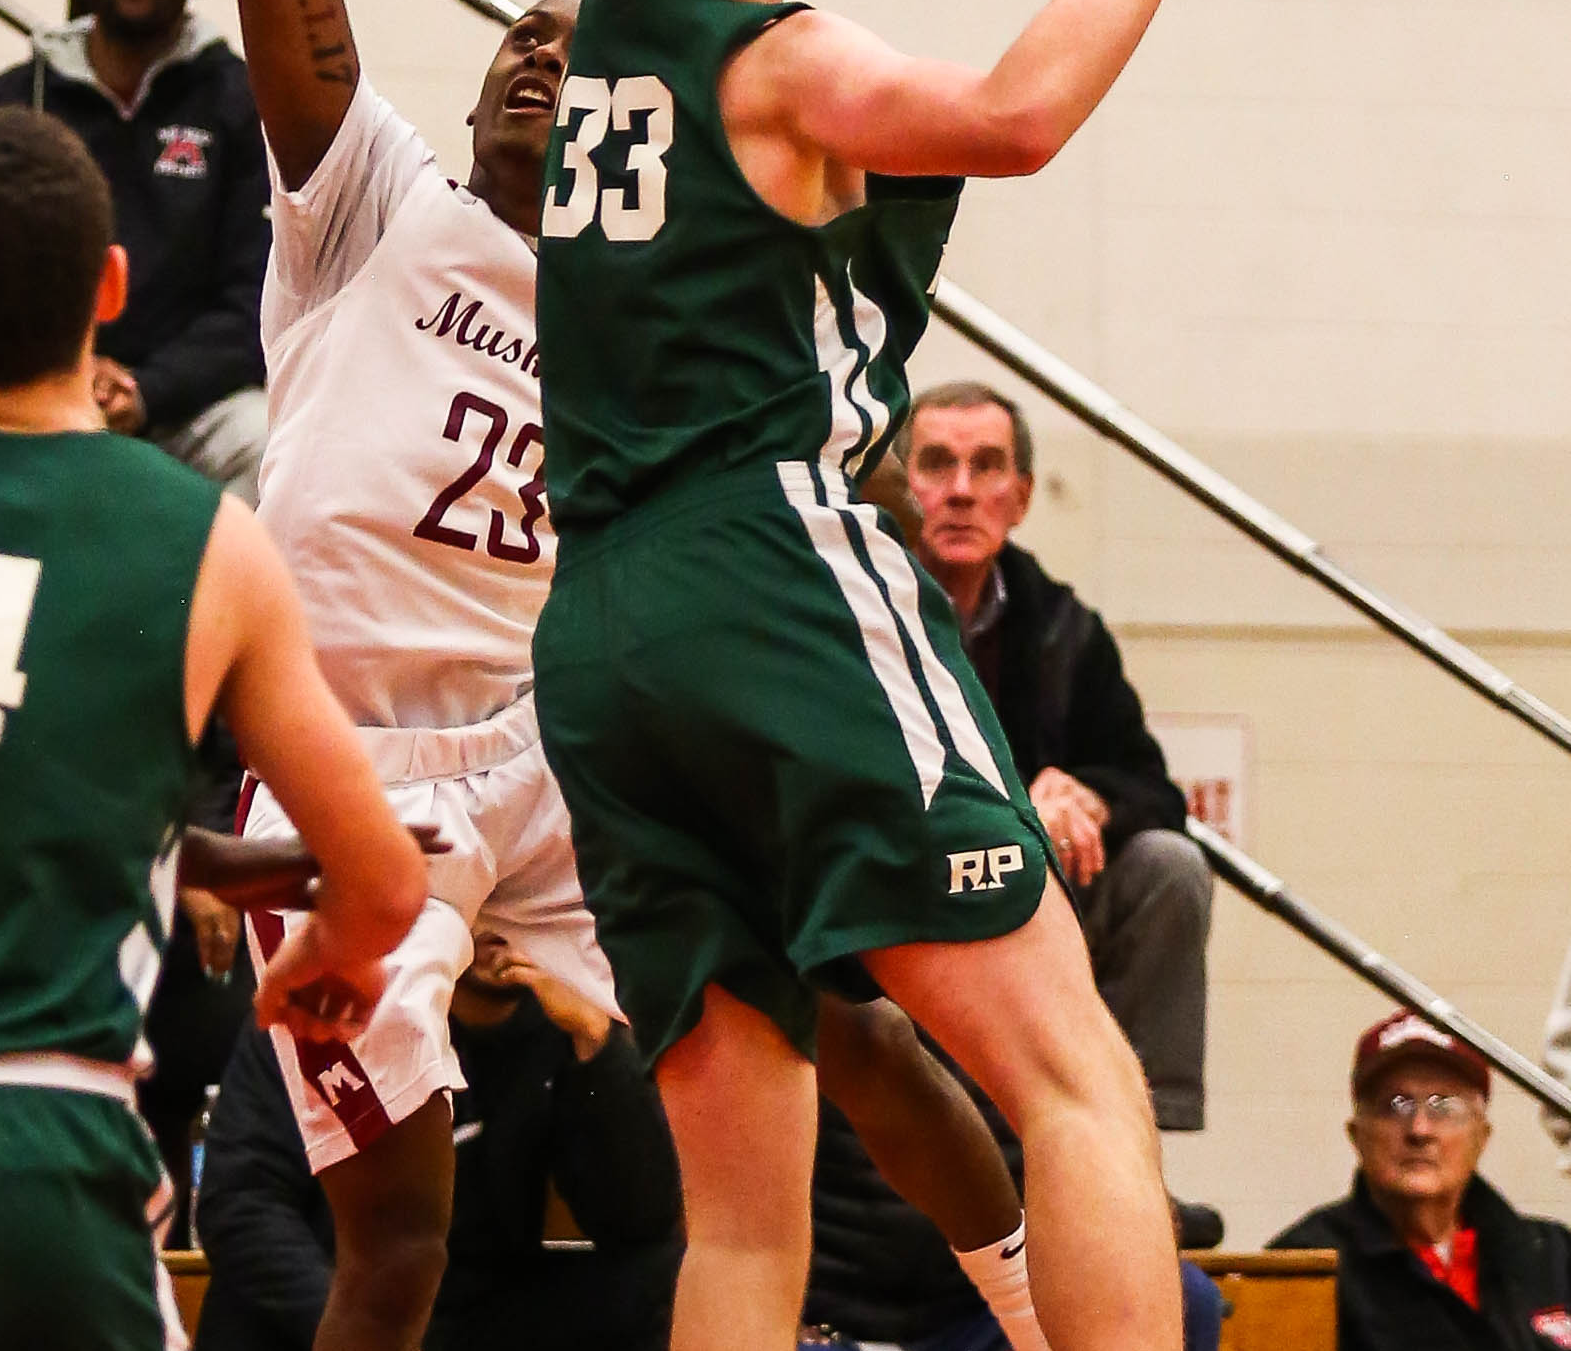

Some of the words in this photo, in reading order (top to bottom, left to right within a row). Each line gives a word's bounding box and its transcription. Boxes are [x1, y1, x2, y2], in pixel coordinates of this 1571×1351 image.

[542, 74, 675, 242] 33
[412, 390, 547, 564] 23
[945, 843, 1025, 895] RP
[317, 1059, 366, 1106] M
